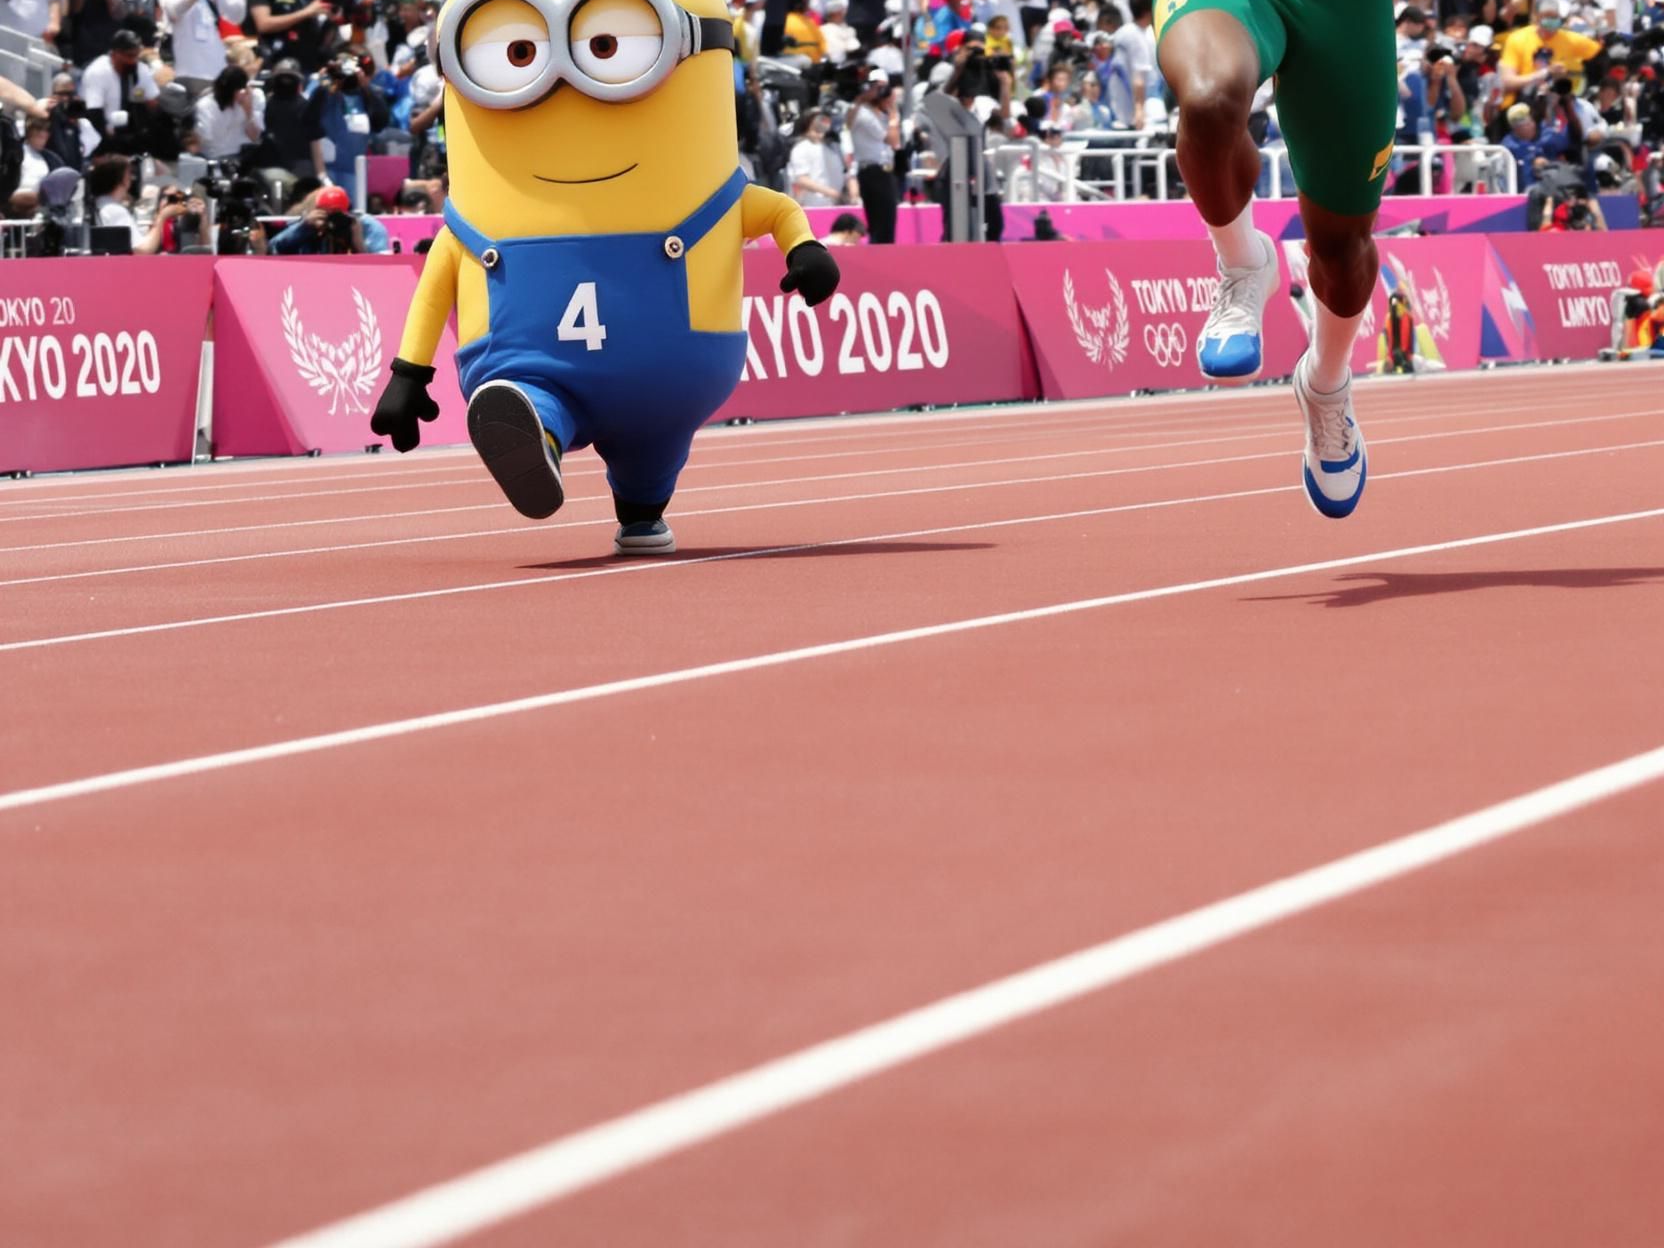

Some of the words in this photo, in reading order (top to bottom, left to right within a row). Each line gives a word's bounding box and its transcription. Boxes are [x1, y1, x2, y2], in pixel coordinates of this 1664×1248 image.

[50, 296, 76, 325] 20
[557, 282, 607, 351] 4
[1130, 278, 1188, 315] TOKYO
[72, 329, 161, 398] 2020
[829, 288, 950, 375] 2020
